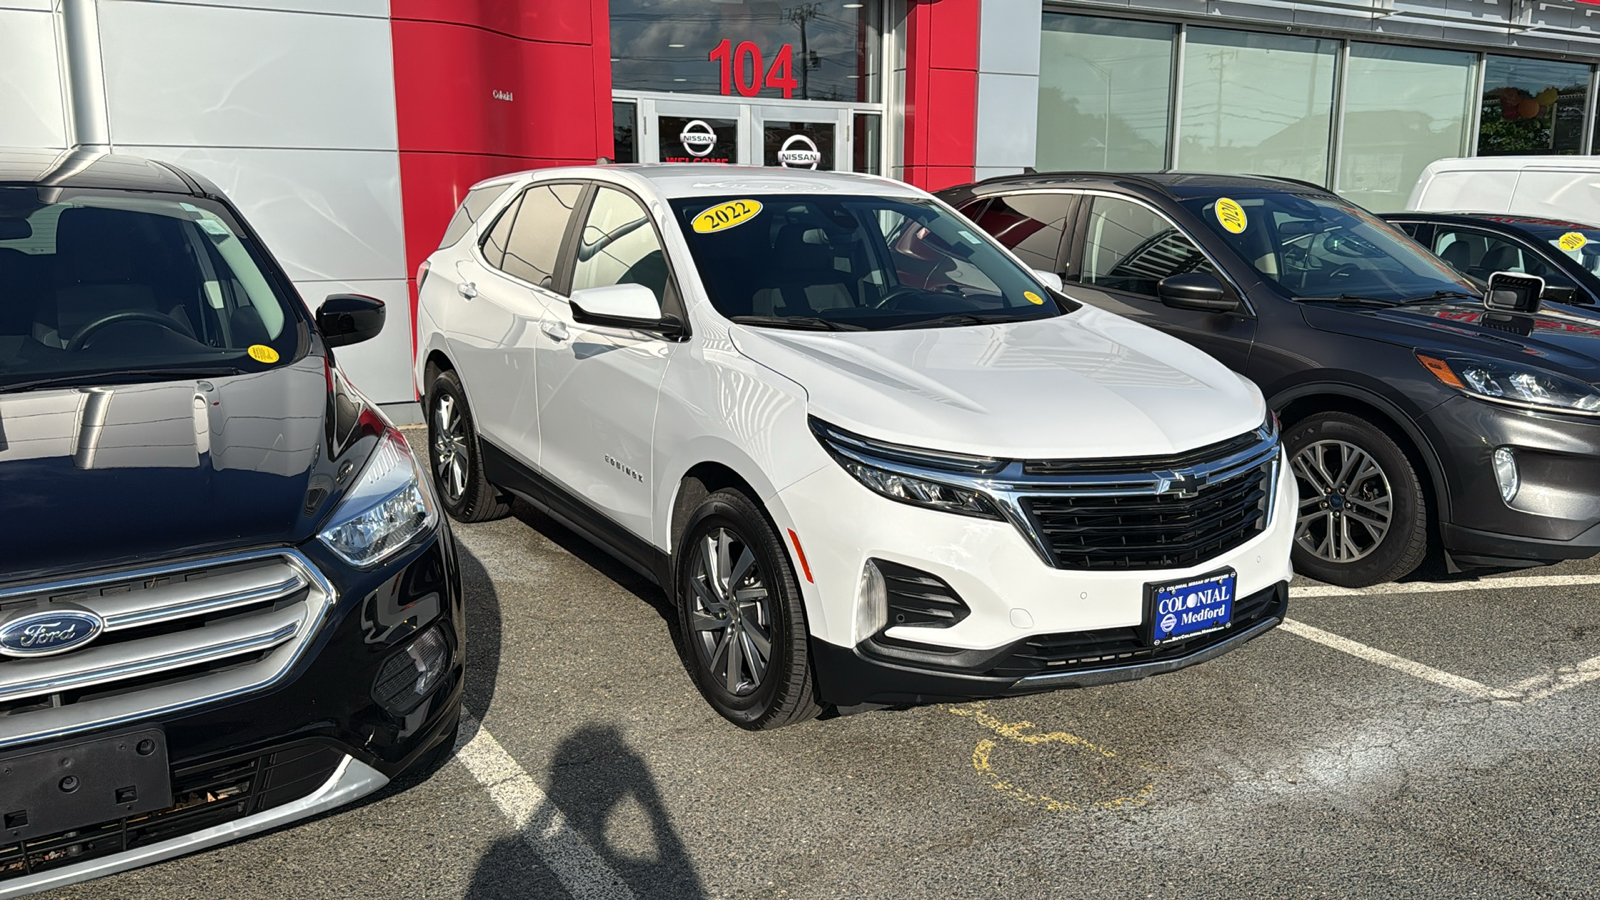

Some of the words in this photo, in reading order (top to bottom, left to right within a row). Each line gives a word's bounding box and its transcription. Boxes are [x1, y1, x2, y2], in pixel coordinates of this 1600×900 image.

[709, 38, 797, 99] 104
[781, 153, 817, 161] NISSAN
[703, 201, 751, 229] 2022
[1220, 201, 1242, 228] 2020
[1562, 234, 1583, 249] 2016
[604, 454, 643, 483] EQUINOX
[1181, 604, 1225, 626] Medford
[20, 621, 76, 647] Ford
